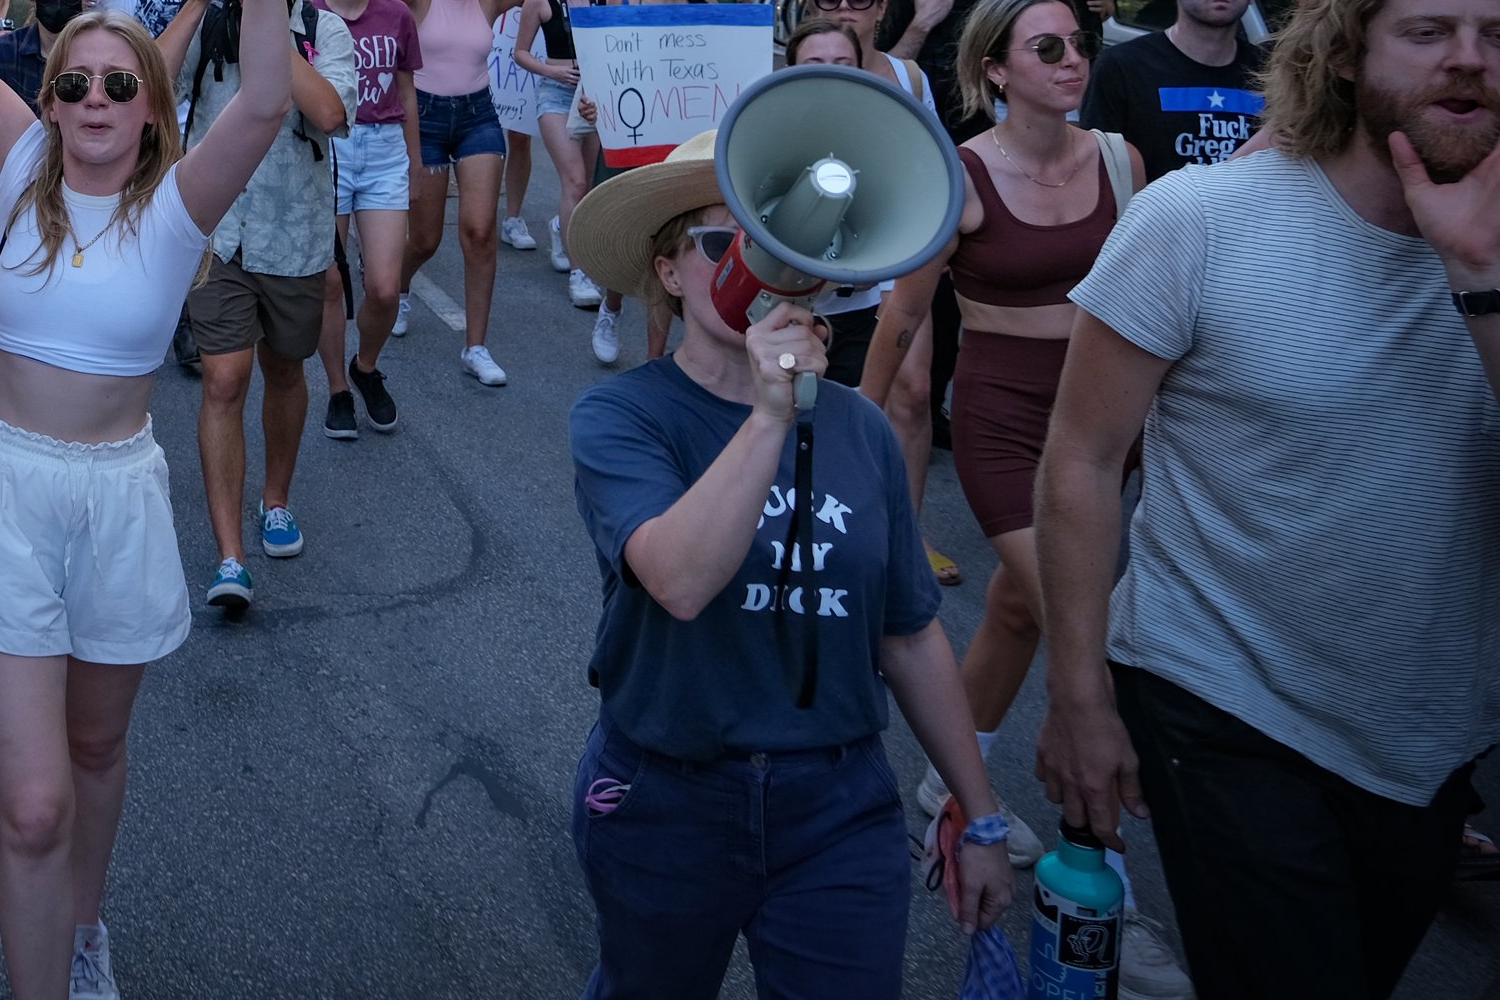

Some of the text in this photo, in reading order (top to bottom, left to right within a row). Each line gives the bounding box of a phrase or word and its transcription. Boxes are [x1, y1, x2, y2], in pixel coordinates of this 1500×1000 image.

[604, 31, 644, 54] Don't
[607, 58, 719, 86] With Texas
[1198, 113, 1252, 140] Fuck
[1174, 132, 1237, 161] Greg
